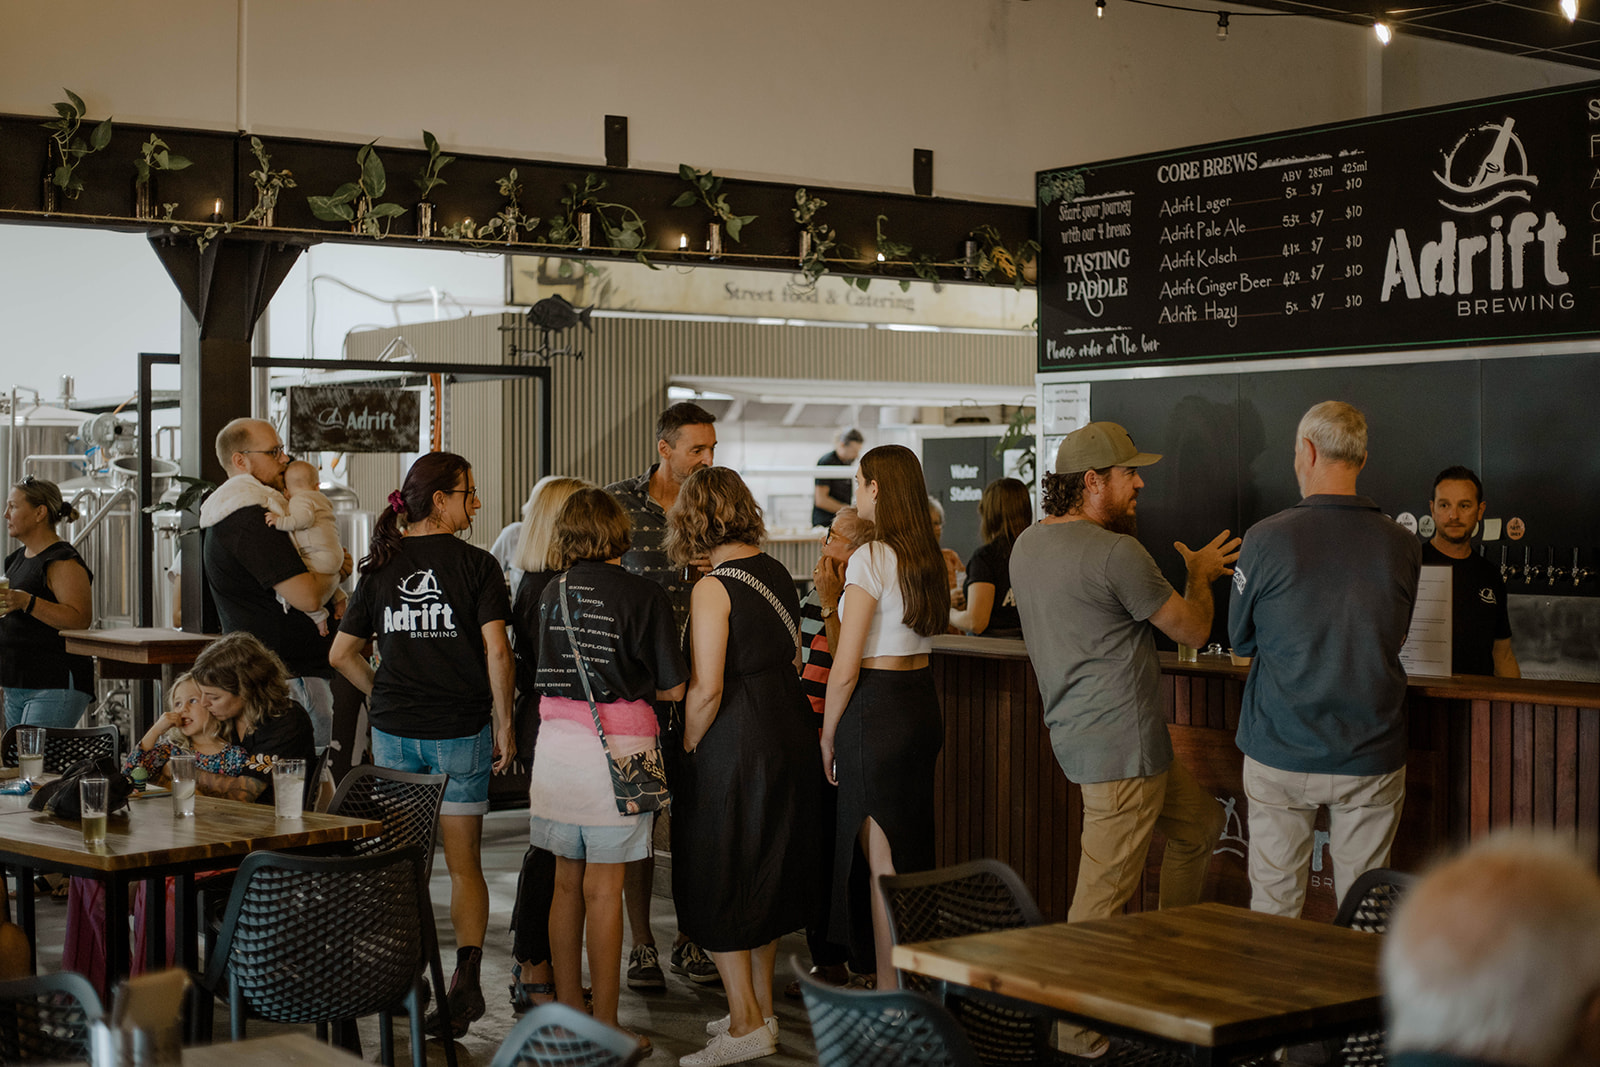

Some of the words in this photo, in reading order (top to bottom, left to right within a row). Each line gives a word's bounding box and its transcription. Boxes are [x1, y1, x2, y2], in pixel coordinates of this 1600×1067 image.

[1157, 160, 1200, 184] CORE
[1203, 152, 1258, 178] BREWS
[1281, 169, 1302, 183] ABV
[1308, 165, 1333, 179] 285ml
[1341, 160, 1368, 174] 425ml
[1159, 196, 1195, 218] Adrift
[1197, 195, 1233, 214] Lager
[1310, 183, 1323, 196] $7
[1345, 177, 1363, 190] $10
[1058, 203, 1081, 222] Start
[1081, 204, 1101, 223] your
[1159, 223, 1196, 245] Adrift
[1197, 220, 1222, 241] Pale
[1223, 217, 1247, 237] Ale
[1310, 209, 1324, 227] $7
[1345, 205, 1363, 220] $10
[1061, 226, 1081, 244] with
[1081, 227, 1096, 241] our
[1097, 223, 1105, 240] 4
[1105, 222, 1132, 240] brews
[1063, 248, 1131, 274] TASTING
[1159, 250, 1196, 272] Adrift
[1197, 246, 1237, 268] Kolsch
[1311, 236, 1324, 255] $7
[1345, 234, 1363, 249] $10
[1380, 211, 1570, 302] Adrift
[1158, 278, 1196, 300] Adrift
[1197, 276, 1239, 297] Ginger
[1240, 272, 1273, 293] Beer
[1310, 263, 1325, 281] $7
[1344, 264, 1363, 278] $10
[724, 281, 774, 302] Street
[845, 291, 916, 312] Catering
[1066, 277, 1128, 317] PADDLE
[1158, 305, 1198, 325] Adrift
[1204, 299, 1238, 328] Hazy
[1310, 292, 1325, 310] $7
[1344, 294, 1363, 308] $10
[1457, 292, 1576, 317] BREWING
[1046, 338, 1077, 360] Please
[1078, 338, 1103, 358] order
[1141, 333, 1161, 353] bar
[346, 405, 397, 431] Adrift
[950, 464, 980, 480] Water
[383, 602, 456, 634] Adrift
[582, 612, 615, 622] CHIHIRO
[410, 631, 458, 639] BREWING
[587, 629, 620, 639] FEATHER
